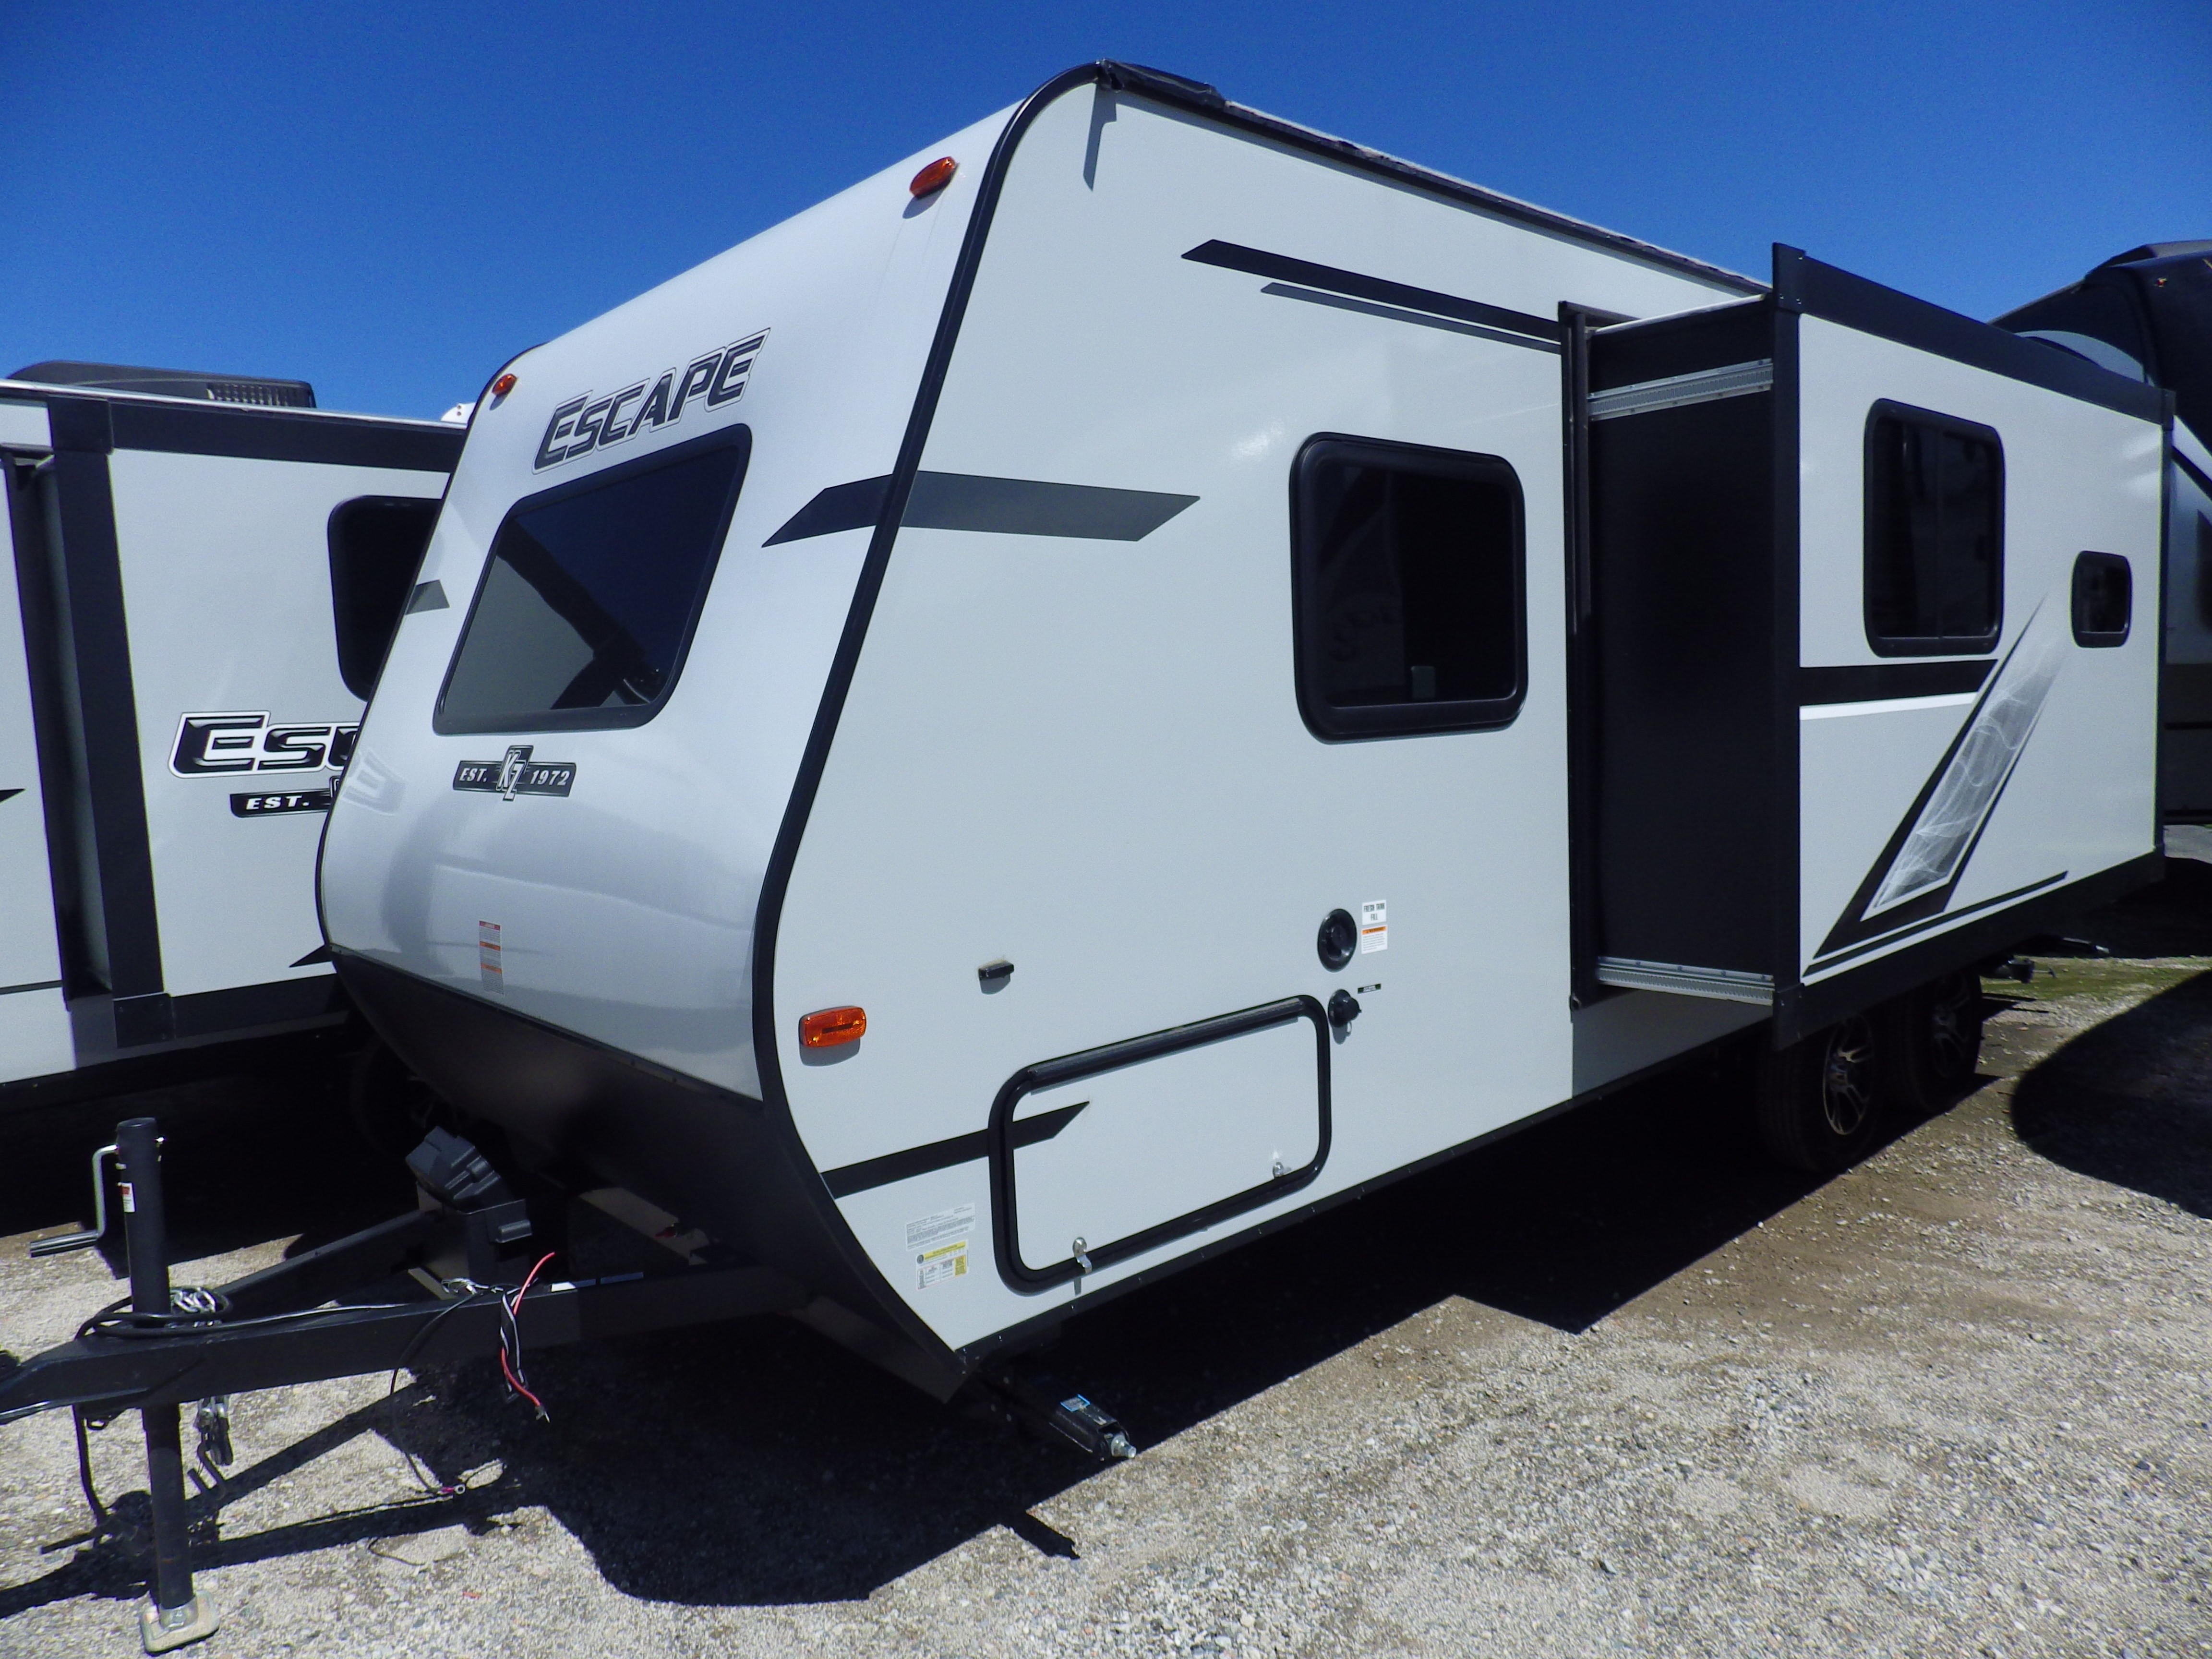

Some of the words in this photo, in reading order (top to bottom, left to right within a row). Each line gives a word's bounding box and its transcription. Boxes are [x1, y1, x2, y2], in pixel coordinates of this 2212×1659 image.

[533, 332, 768, 471] ESCAPE
[459, 768, 488, 782] EST.
[530, 769, 570, 786] 1972
[245, 795, 310, 810] EST.
